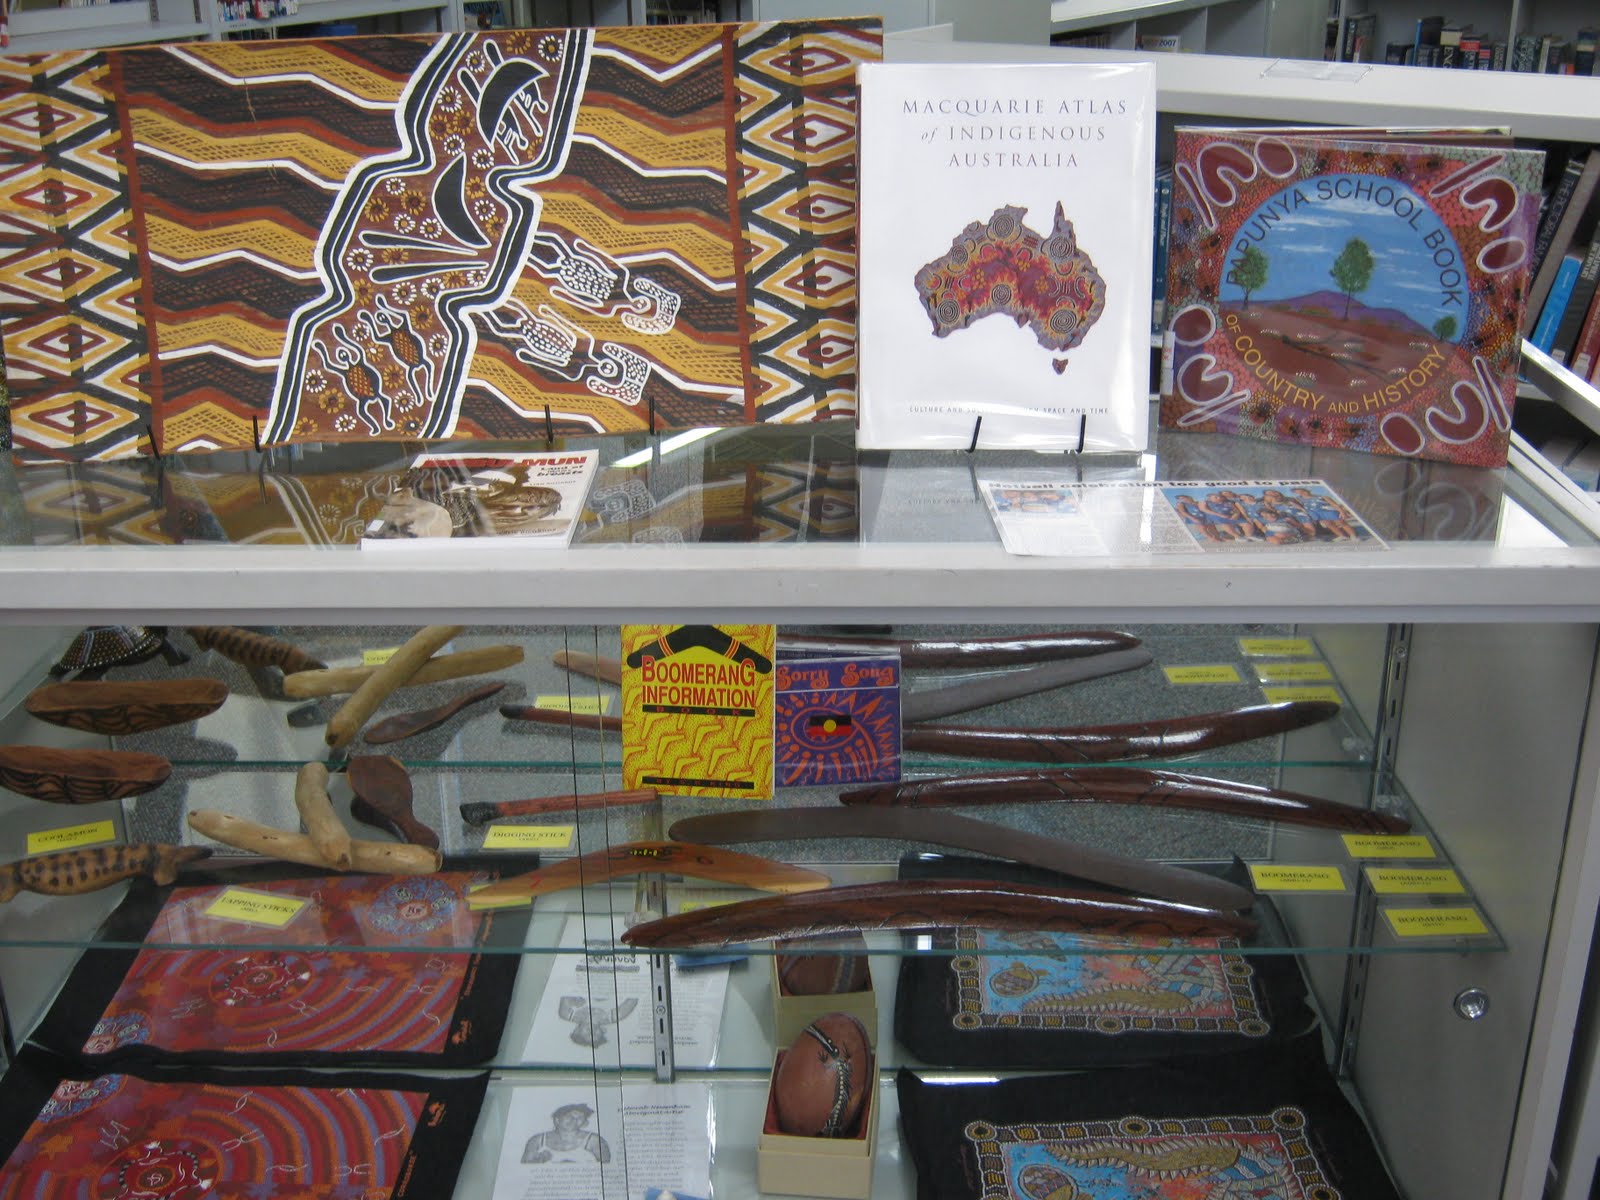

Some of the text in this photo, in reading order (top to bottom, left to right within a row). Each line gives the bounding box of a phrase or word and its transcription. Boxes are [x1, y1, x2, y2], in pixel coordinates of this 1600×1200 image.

[903, 99, 1127, 116] MACQUARIE ATLAS
[921, 126, 1105, 143] of INDIGENOUS
[949, 153, 1078, 168] AUSTRALIA
[1226, 190, 1310, 286] PAPUNYA
[1316, 178, 1423, 232] SCHOOL
[1423, 230, 1463, 307] BOOK
[1225, 313, 1447, 414] OF COUNTRY AND HISTORY
[641, 655, 756, 687] BOOMERANG
[776, 663, 895, 691] Sorry Song
[641, 685, 756, 708] INFORMATION
[656, 705, 740, 716] BOOK
[1397, 915, 1468, 923] BOOMERANG
